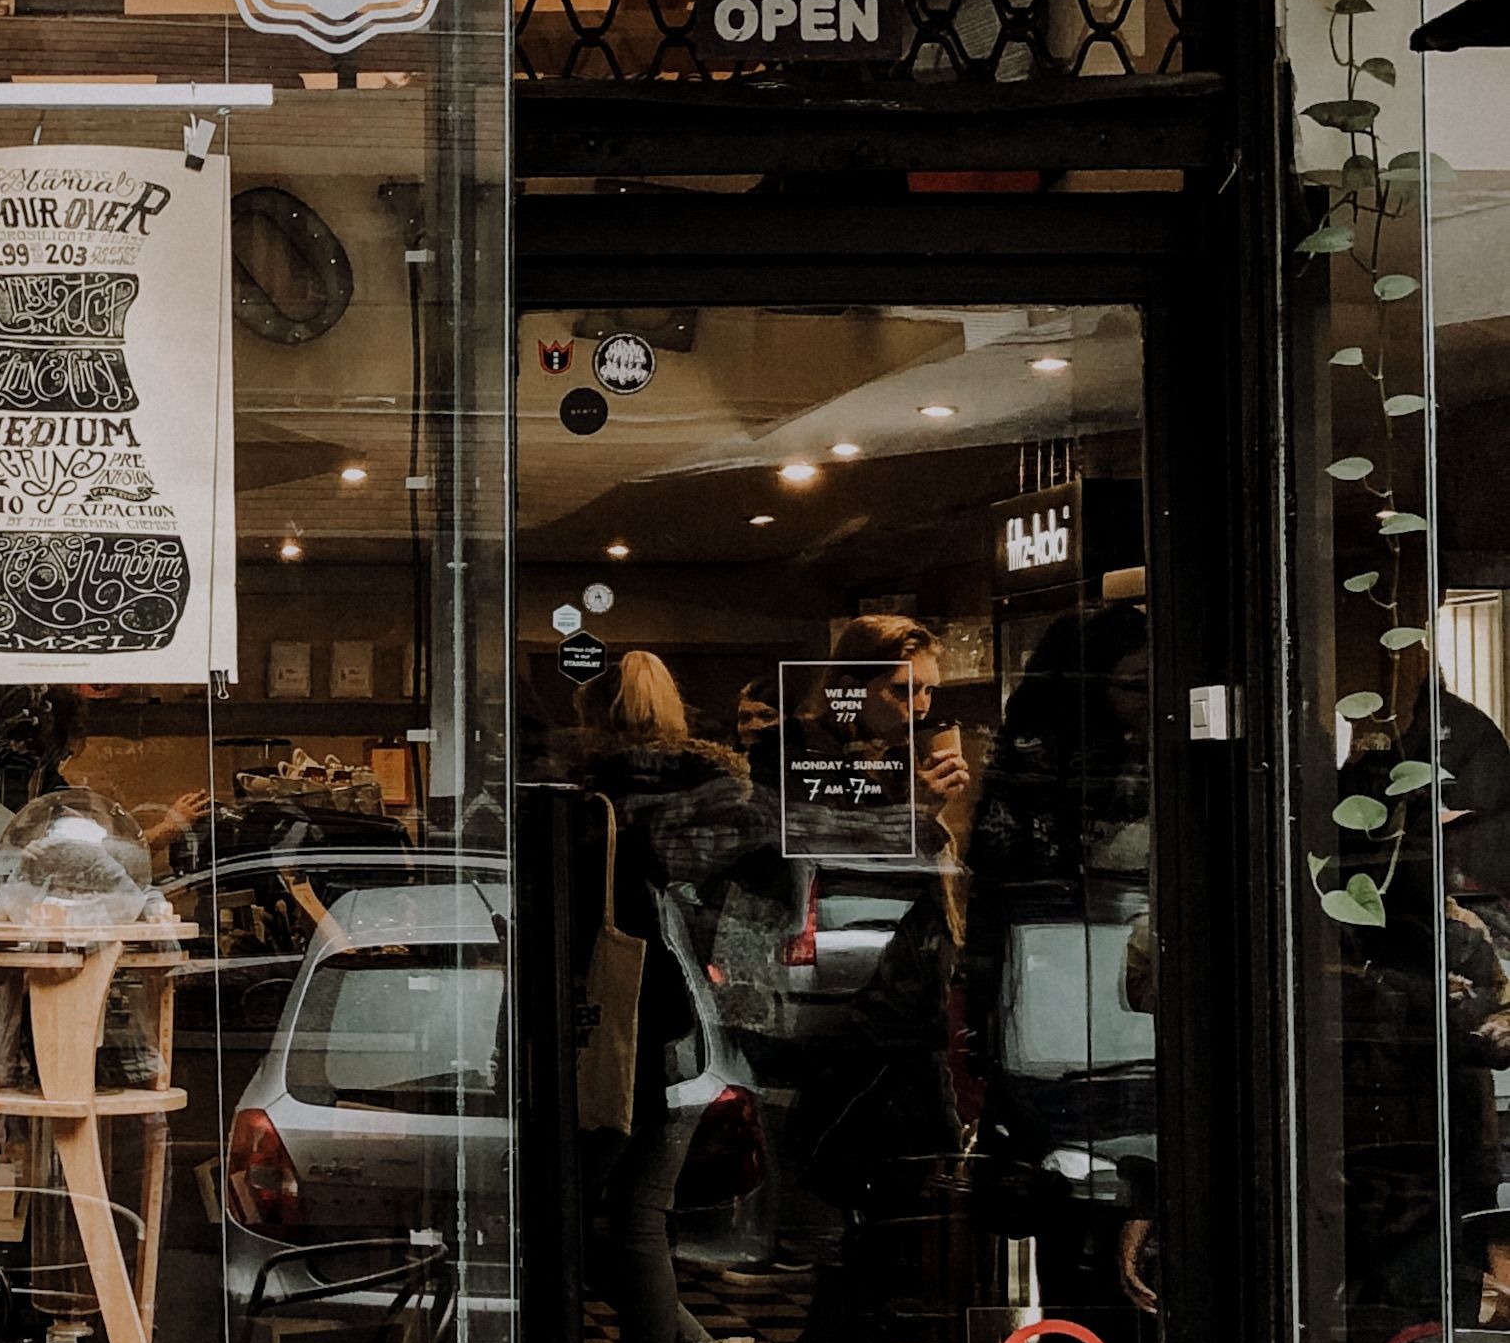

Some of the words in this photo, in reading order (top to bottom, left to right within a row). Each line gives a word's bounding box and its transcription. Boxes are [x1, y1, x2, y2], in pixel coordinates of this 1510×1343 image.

[45, 244, 87, 266] 203
[62, 503, 176, 519] EXTRACTION
[824, 688, 843, 698] WE
[846, 688, 867, 698] ARE
[830, 700, 862, 710] OPEN
[836, 712, 857, 723] 7/7
[791, 760, 843, 771] MONDAY
[852, 760, 904, 771] SUNDAY:
